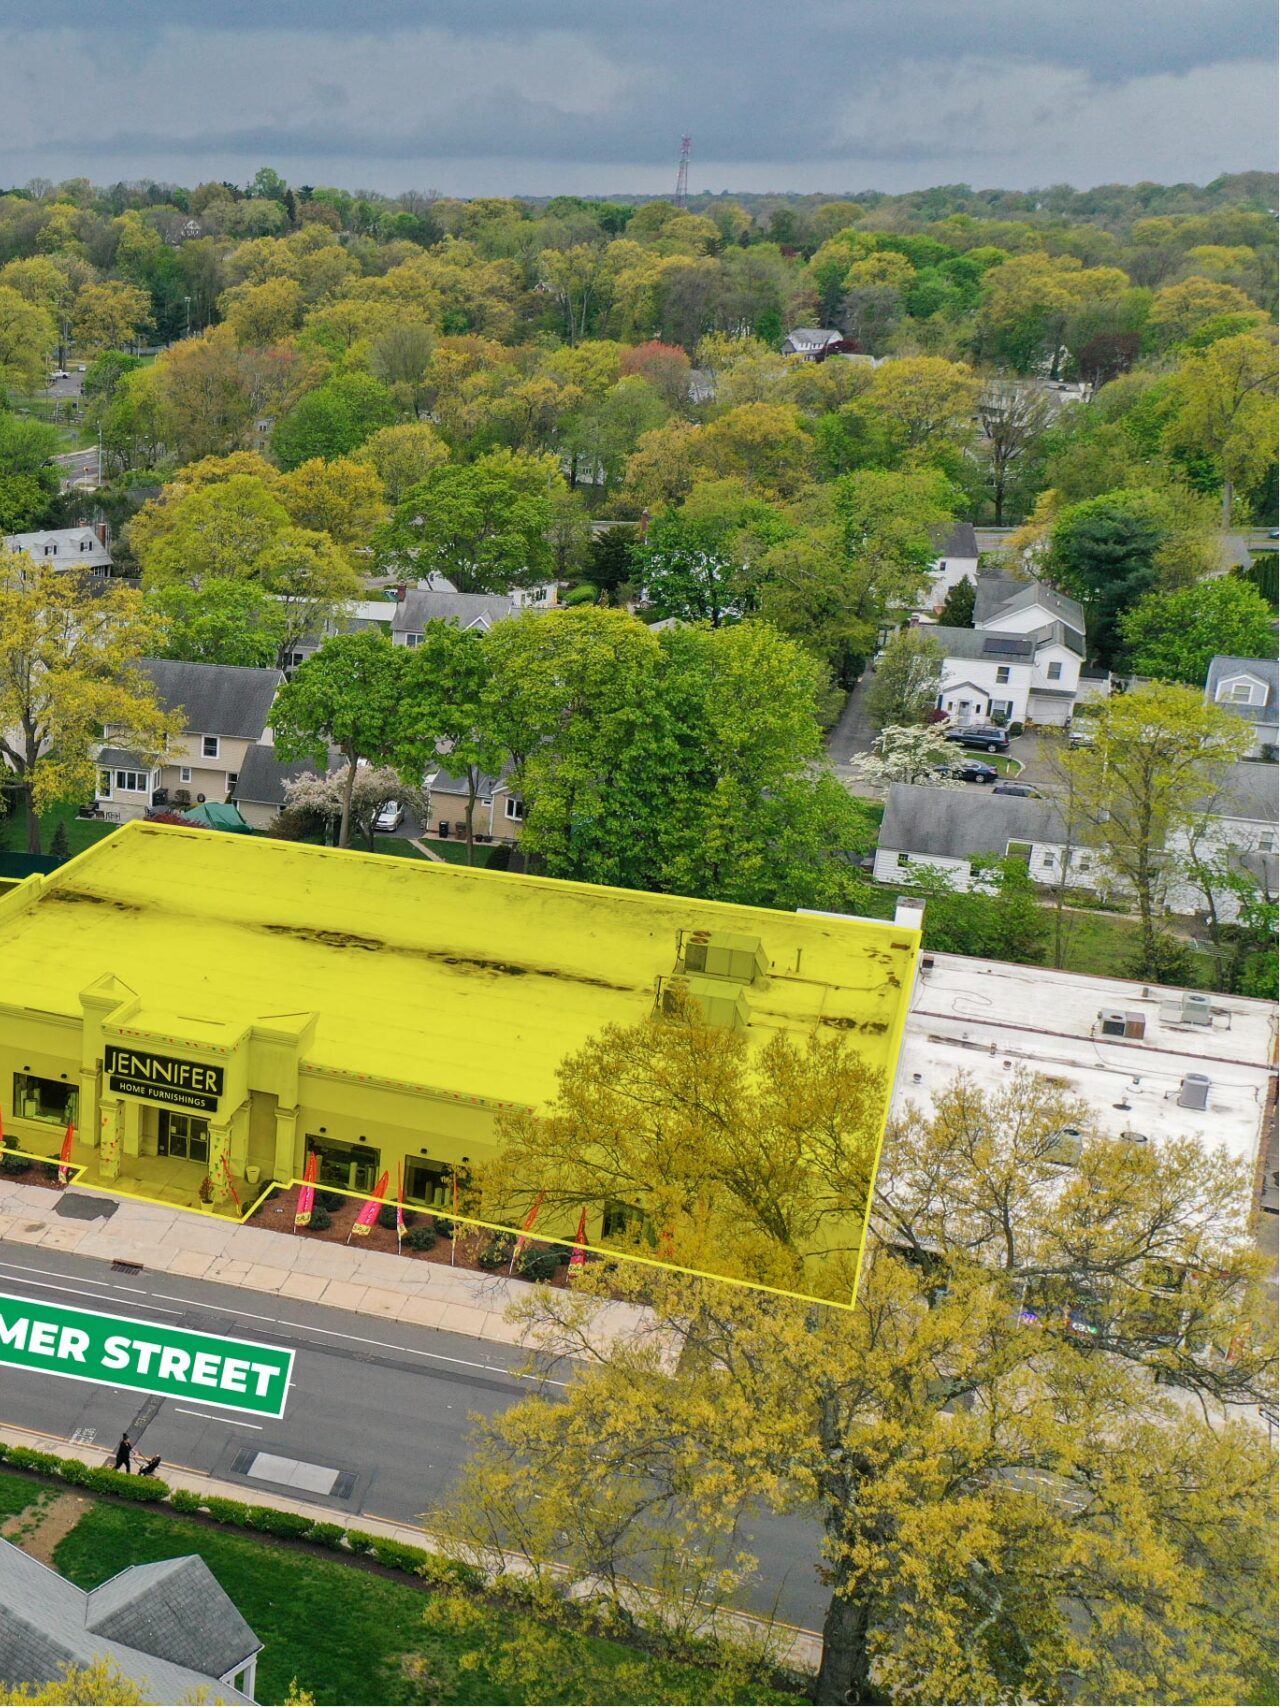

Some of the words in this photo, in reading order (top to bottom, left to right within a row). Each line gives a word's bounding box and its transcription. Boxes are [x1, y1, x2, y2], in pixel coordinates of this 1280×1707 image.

[107, 1051, 218, 1092] JENNIFER
[119, 1082, 146, 1095] HOME
[148, 1088, 207, 1107] FURNISHINGS
